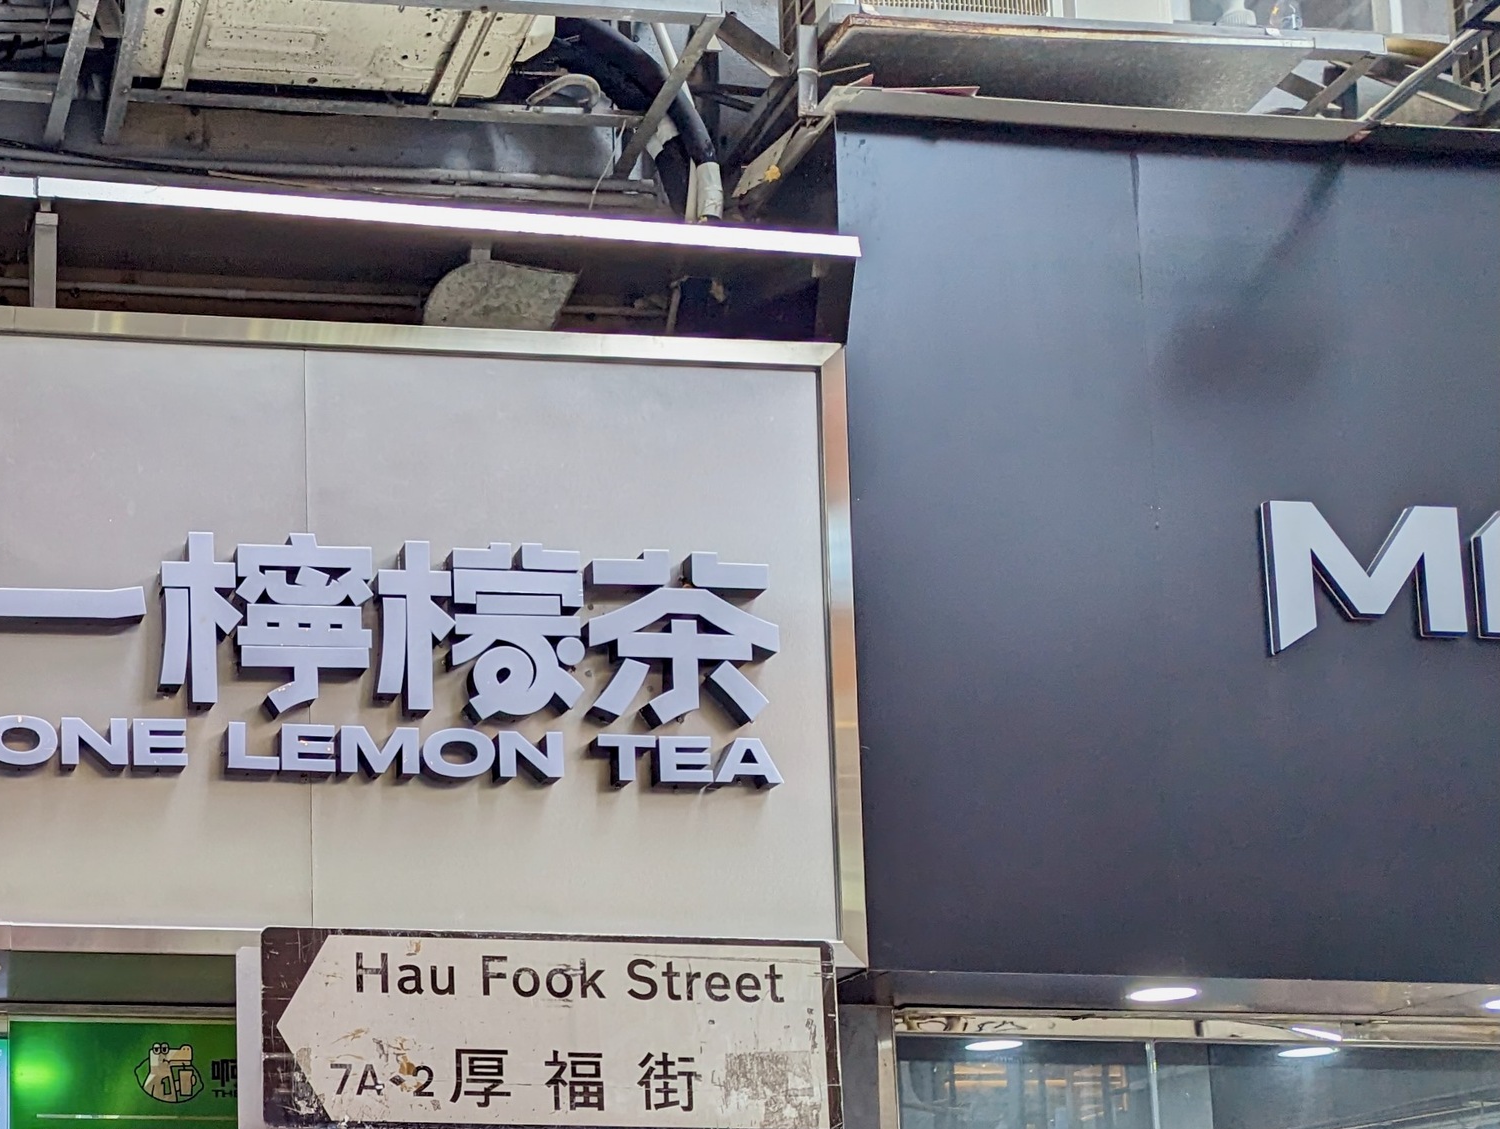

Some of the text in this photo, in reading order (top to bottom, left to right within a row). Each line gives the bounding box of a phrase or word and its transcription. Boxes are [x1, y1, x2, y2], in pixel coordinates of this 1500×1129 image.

[224, 723, 564, 784] LEMON
[591, 733, 785, 789] TEA
[355, 952, 785, 1004] Hau Fook Street
